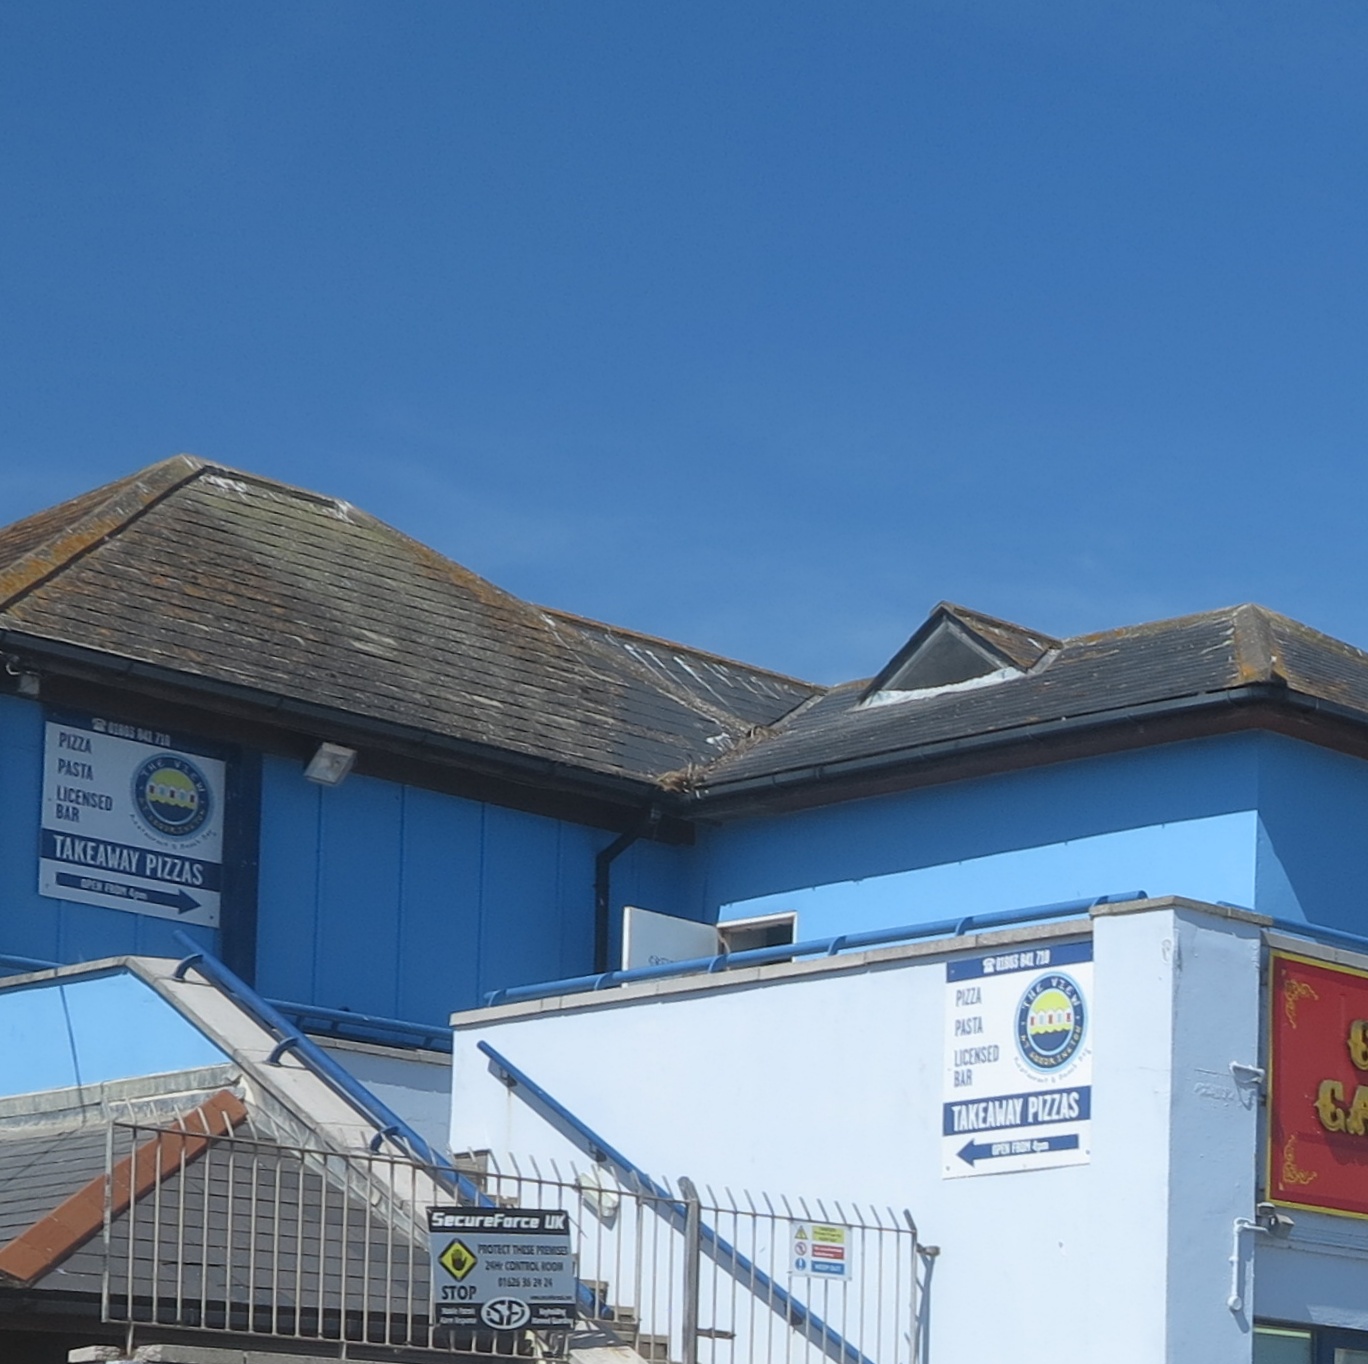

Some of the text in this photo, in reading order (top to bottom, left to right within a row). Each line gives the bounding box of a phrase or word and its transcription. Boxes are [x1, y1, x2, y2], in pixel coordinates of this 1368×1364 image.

[59, 732, 92, 753] PIZZA
[58, 758, 94, 781] PASTA
[141, 760, 206, 792] THE VIEW
[56, 785, 113, 811] LICENSED
[55, 803, 80, 823] BAR
[53, 835, 203, 885] TAKEAWAY PIZZAS
[80, 878, 101, 891] OPEN
[105, 883, 128, 897] FROM
[956, 987, 982, 1007] PIZZA
[1022, 977, 1081, 1009] THE VIEW
[955, 1016, 983, 1037] PASTA
[954, 1044, 1000, 1067] LICENSED
[953, 1069, 973, 1087] BAR
[952, 1092, 1080, 1132] TAKEAWAY PIZZAS
[991, 1140, 1049, 1156] OPEN FROM 4pm
[431, 1212, 565, 1230] SecureForce UK
[477, 1244, 568, 1256] PROTECT THESE PREMISES
[505, 1261, 539, 1272] CONTROL
[541, 1262, 564, 1272] ROOM
[441, 1285, 477, 1300] STOP
